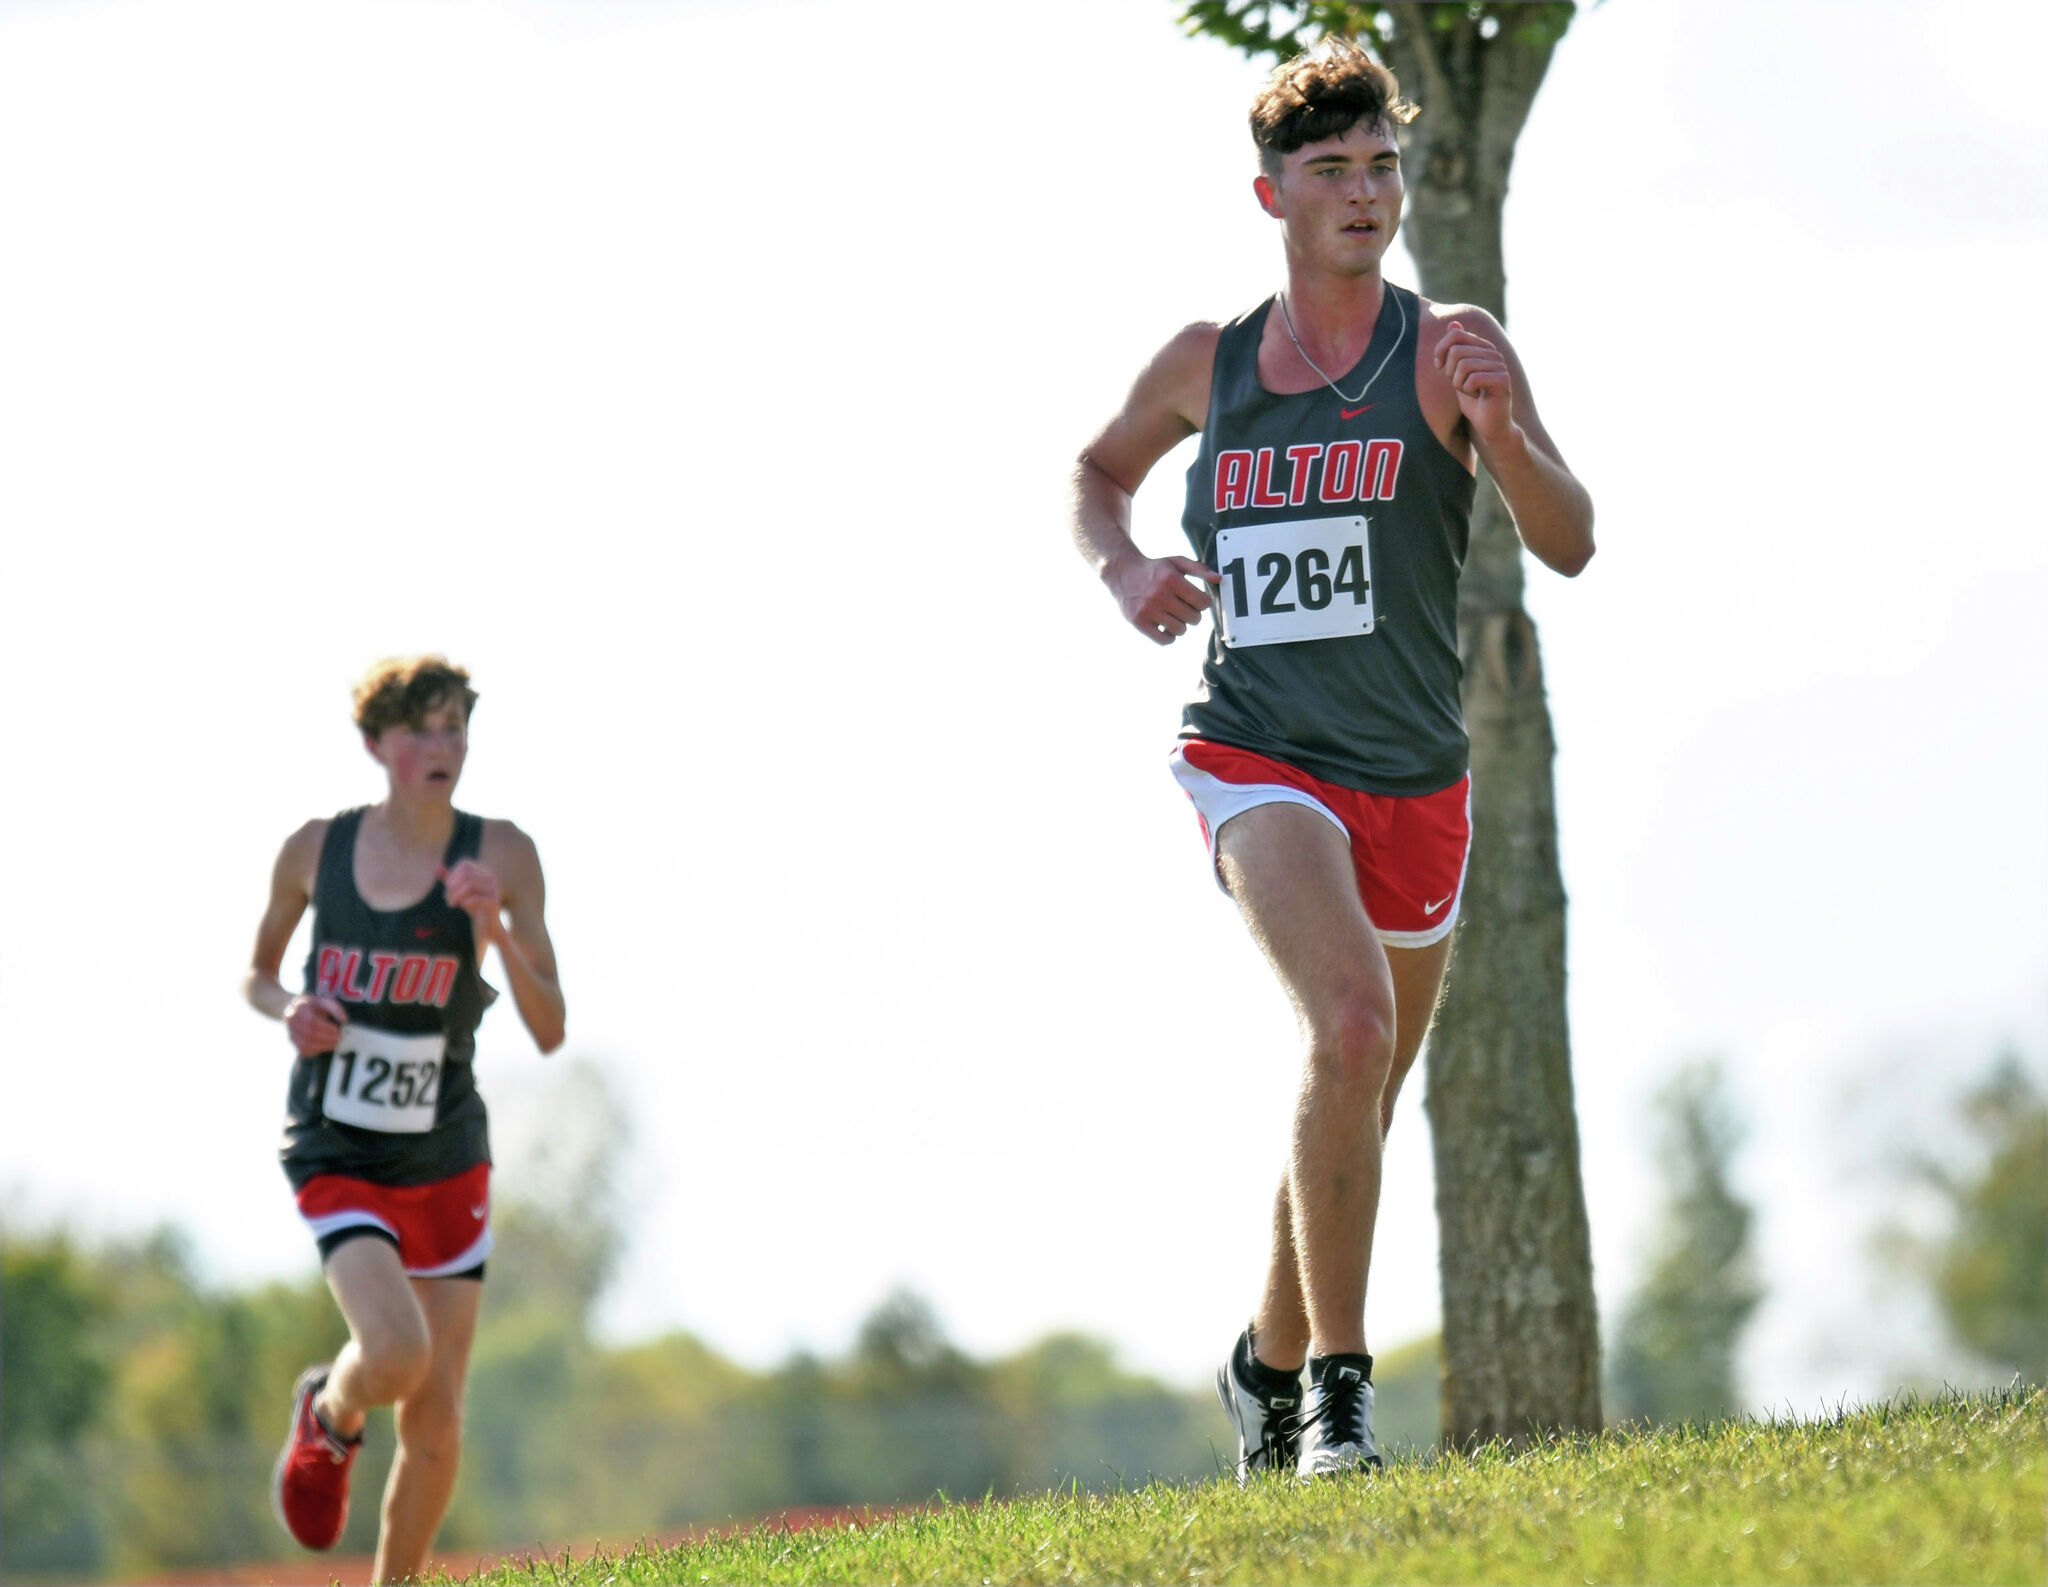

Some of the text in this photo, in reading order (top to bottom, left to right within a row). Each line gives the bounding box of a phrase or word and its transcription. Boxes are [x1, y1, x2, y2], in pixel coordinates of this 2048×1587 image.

[1215, 439, 1404, 512] ALTON
[1222, 545, 1370, 618] 1264
[317, 946, 459, 1007] ALTON
[338, 1050, 438, 1108] 1252
